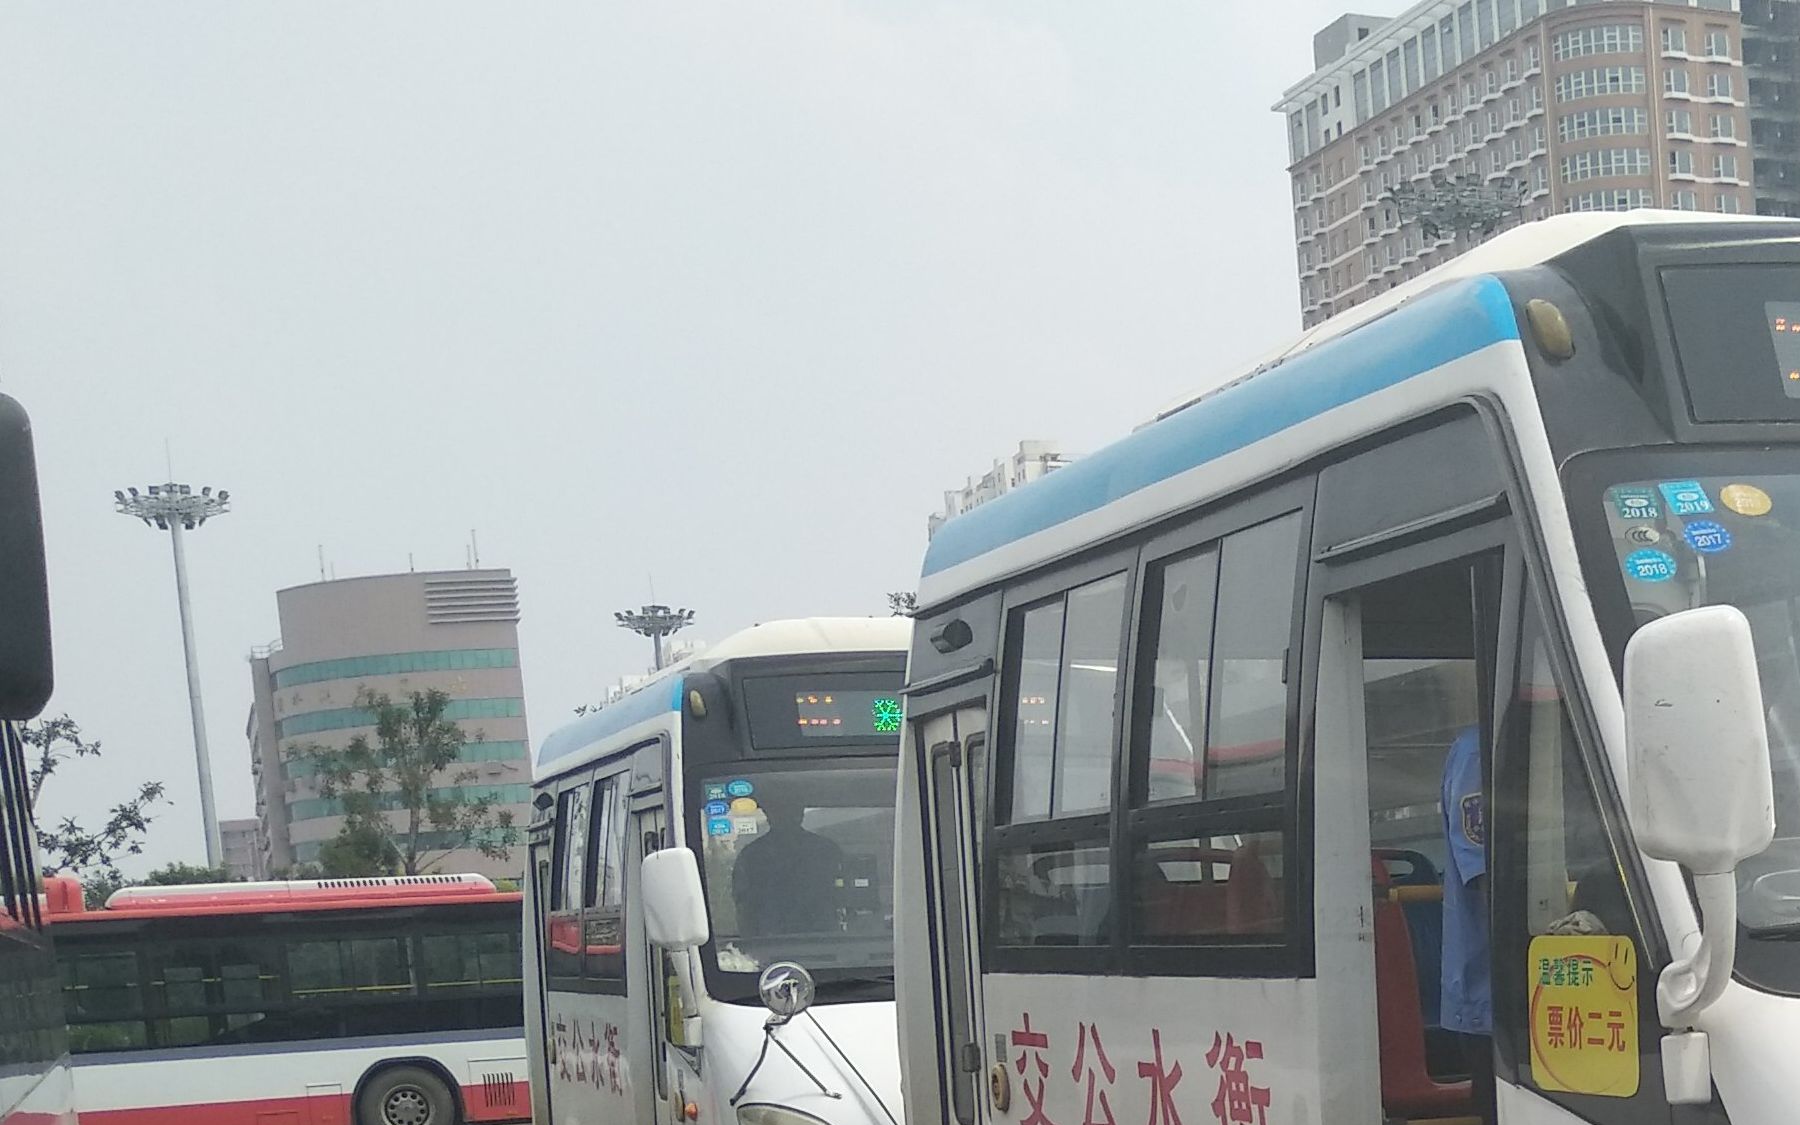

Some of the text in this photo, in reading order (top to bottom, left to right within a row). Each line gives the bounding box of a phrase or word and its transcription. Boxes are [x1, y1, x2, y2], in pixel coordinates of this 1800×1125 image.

[1622, 506, 1658, 518] 2018
[1677, 500, 1710, 513] 2019
[1694, 533, 1722, 547] 2017
[1637, 563, 1668, 576] 2018
[1538, 957, 1594, 987] 温馨提示
[1547, 1005, 1626, 1052] 票价二元
